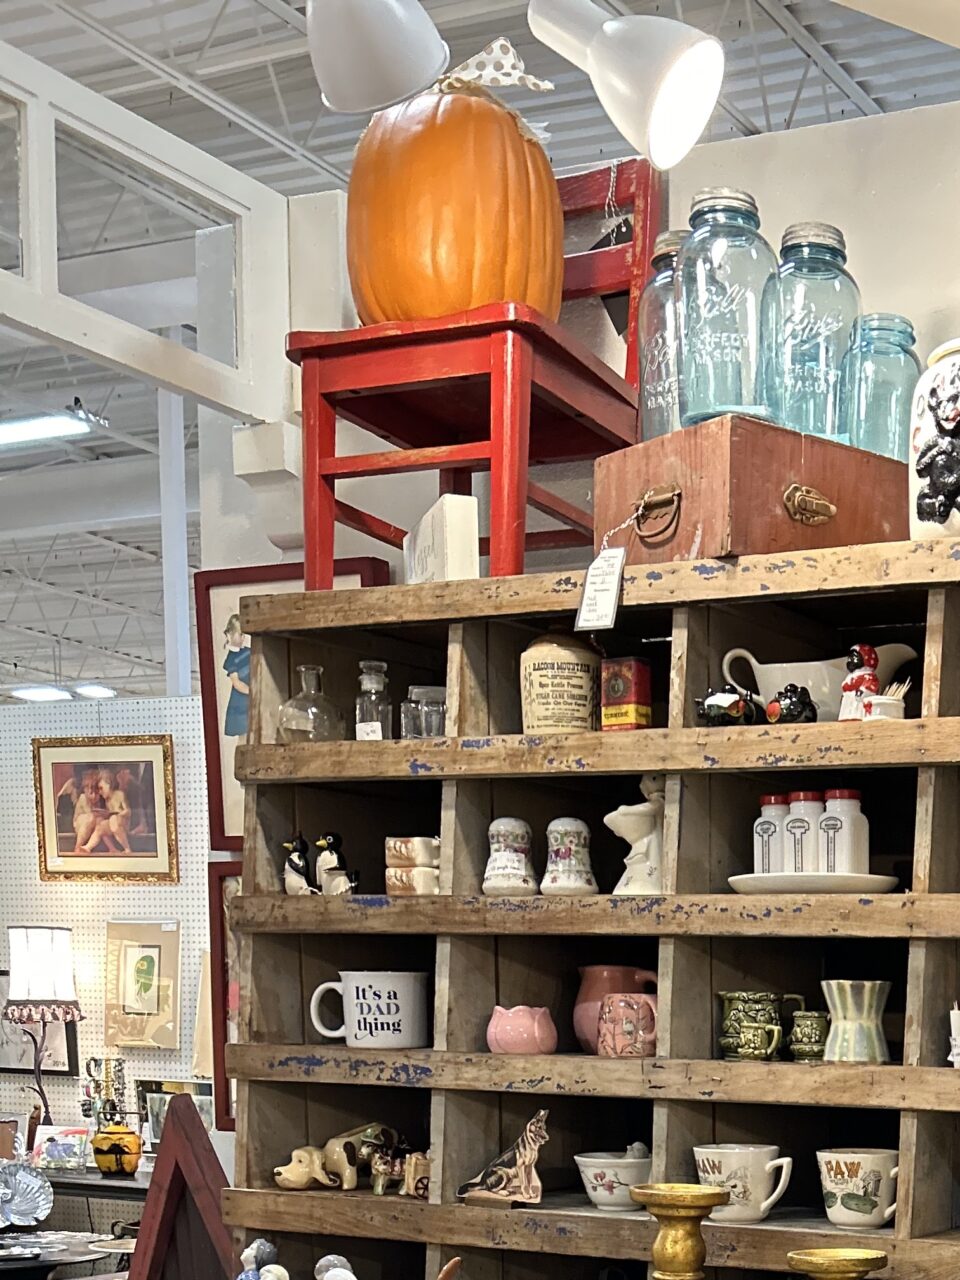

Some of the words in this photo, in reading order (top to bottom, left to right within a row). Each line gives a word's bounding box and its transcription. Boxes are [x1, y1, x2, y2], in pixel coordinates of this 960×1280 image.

[355, 984, 382, 1000] It's
[387, 989, 398, 1000] a
[355, 1002, 400, 1015] DAD
[354, 1017, 402, 1041] thing
[824, 1159, 861, 1178] PAW
